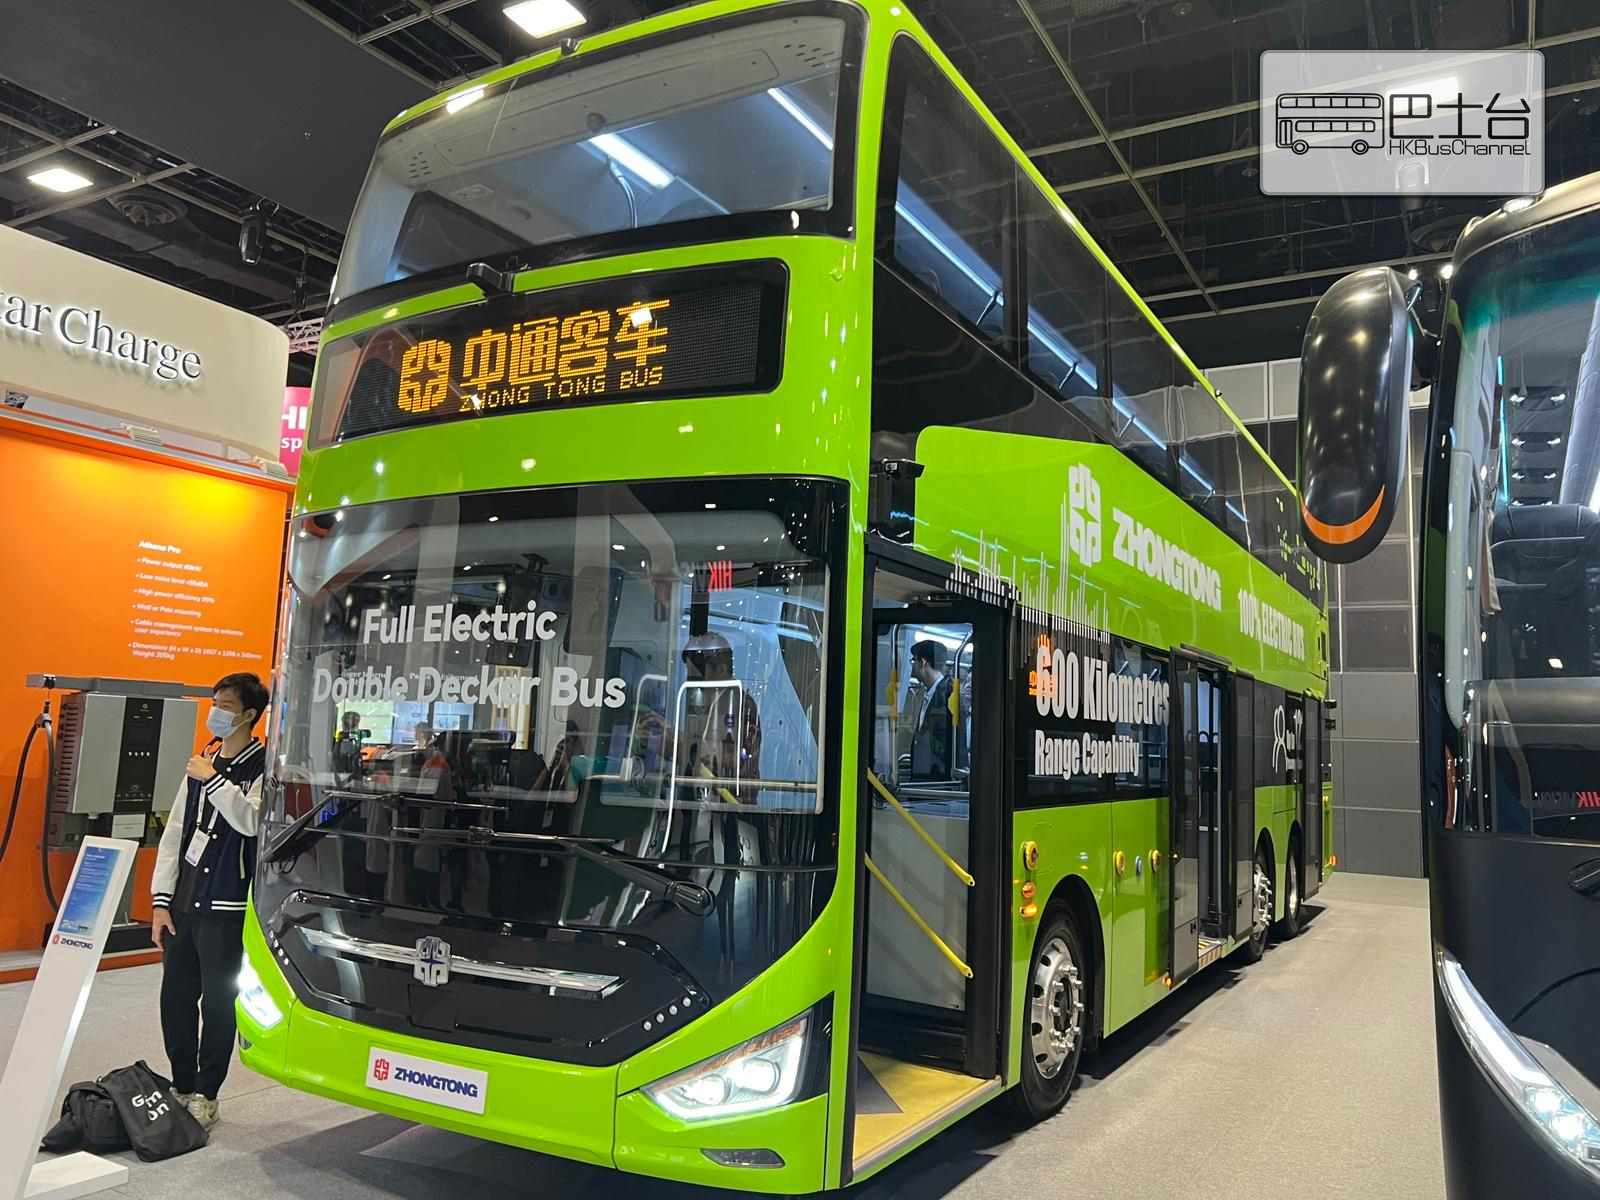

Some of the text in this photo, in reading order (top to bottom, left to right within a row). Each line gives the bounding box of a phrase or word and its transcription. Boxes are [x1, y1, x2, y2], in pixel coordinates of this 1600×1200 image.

[58, 306, 202, 380] Charge
[459, 299, 670, 390] 中通客车
[458, 366, 663, 412] ZHONG TONG BUS
[141, 557, 161, 566] Power
[1112, 507, 1222, 611] ZHONGTONG
[136, 603, 152, 611] Wall
[138, 588, 153, 596] High
[154, 591, 173, 599] power
[149, 629, 181, 637] experience
[153, 621, 193, 631] management
[362, 600, 558, 645] Full Electric
[132, 649, 155, 659] Weight
[312, 665, 626, 709] Double Decker Bus
[1036, 645, 1170, 726] 600 Kilometres
[1034, 730, 1139, 780] Range Capability
[60, 938, 93, 949] ZHONGTONG
[394, 1067, 479, 1098] ZHONGTONG
